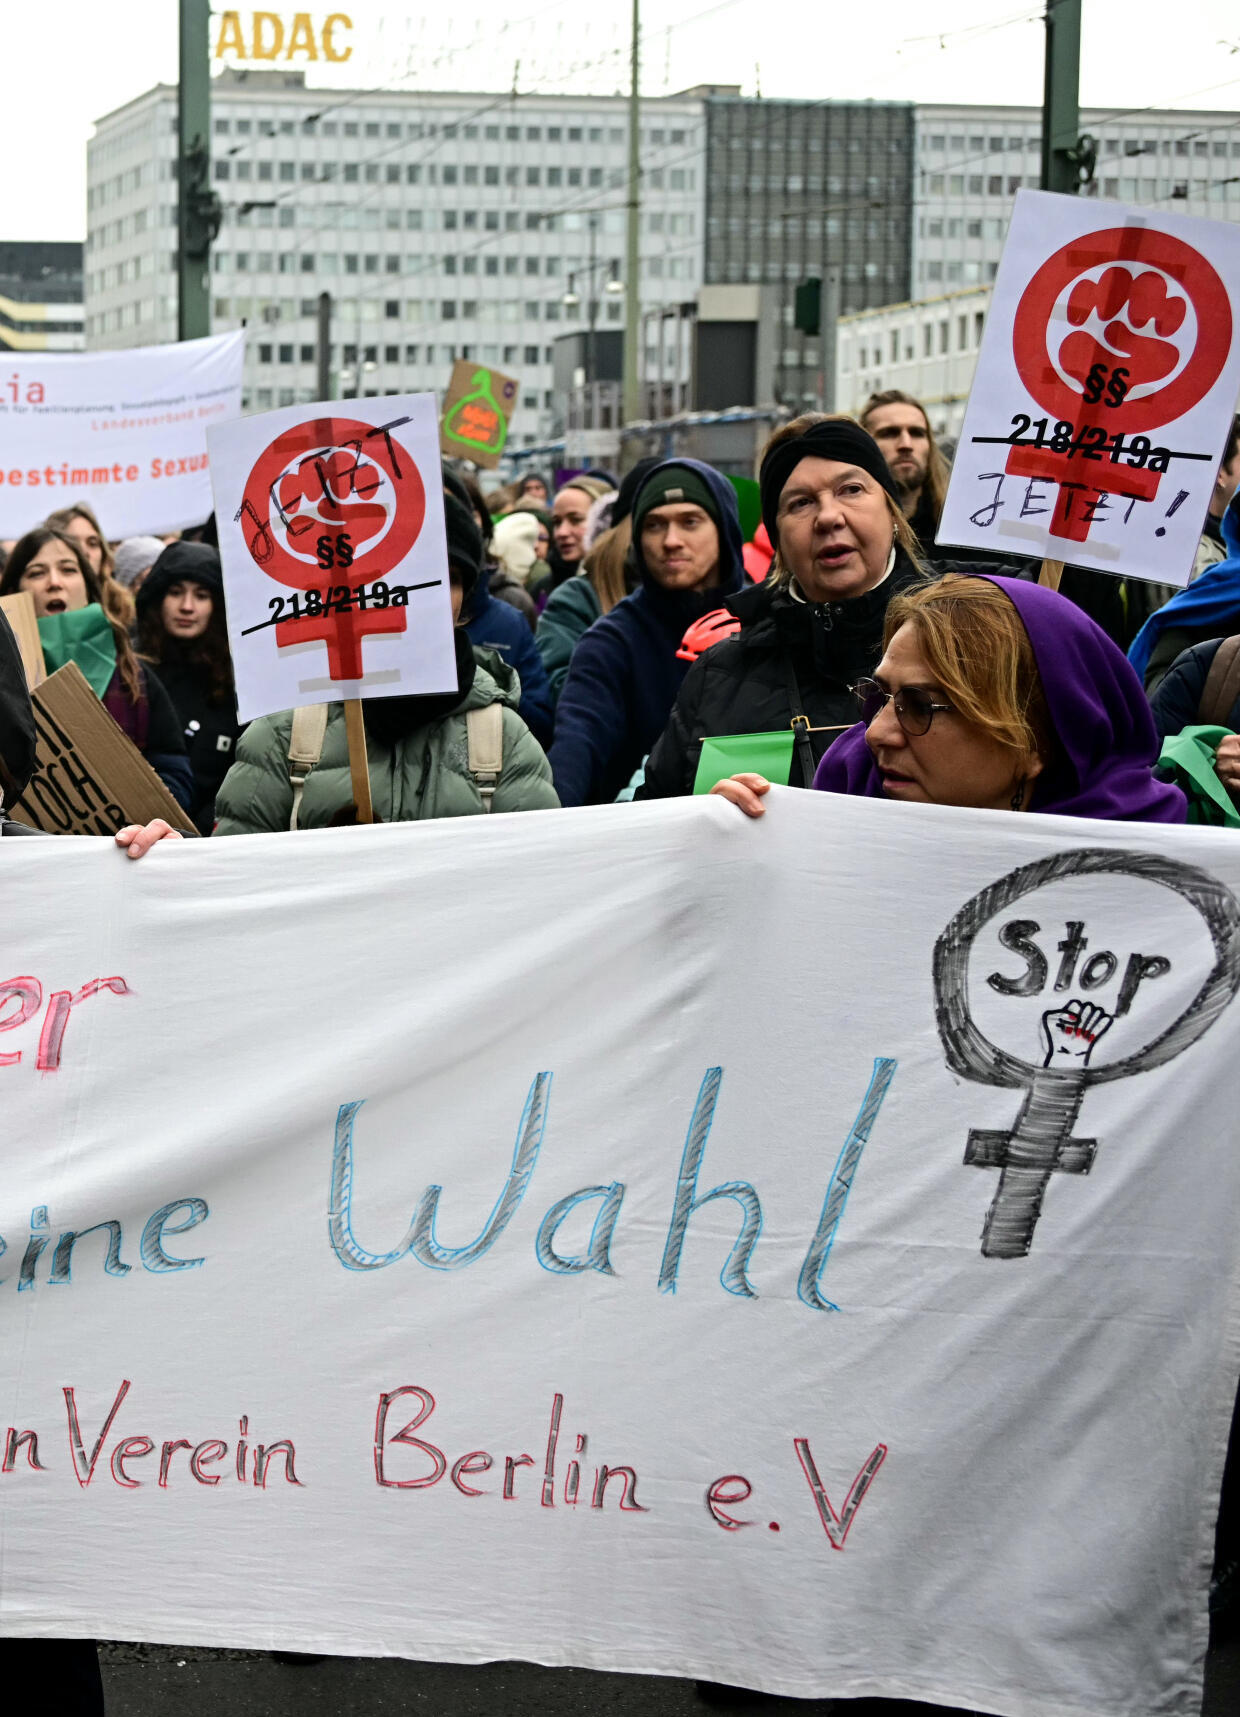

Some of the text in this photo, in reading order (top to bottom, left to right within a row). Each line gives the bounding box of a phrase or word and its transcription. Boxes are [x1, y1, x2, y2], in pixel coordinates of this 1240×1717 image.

[215, 10, 354, 63] ADAC
[1007, 413, 1171, 474] 218/219a
[268, 581, 410, 624] 218/219a
[986, 919, 1171, 1018] Stop
[328, 1057, 897, 1312] Wahl
[374, 1385, 650, 1512] Berlin
